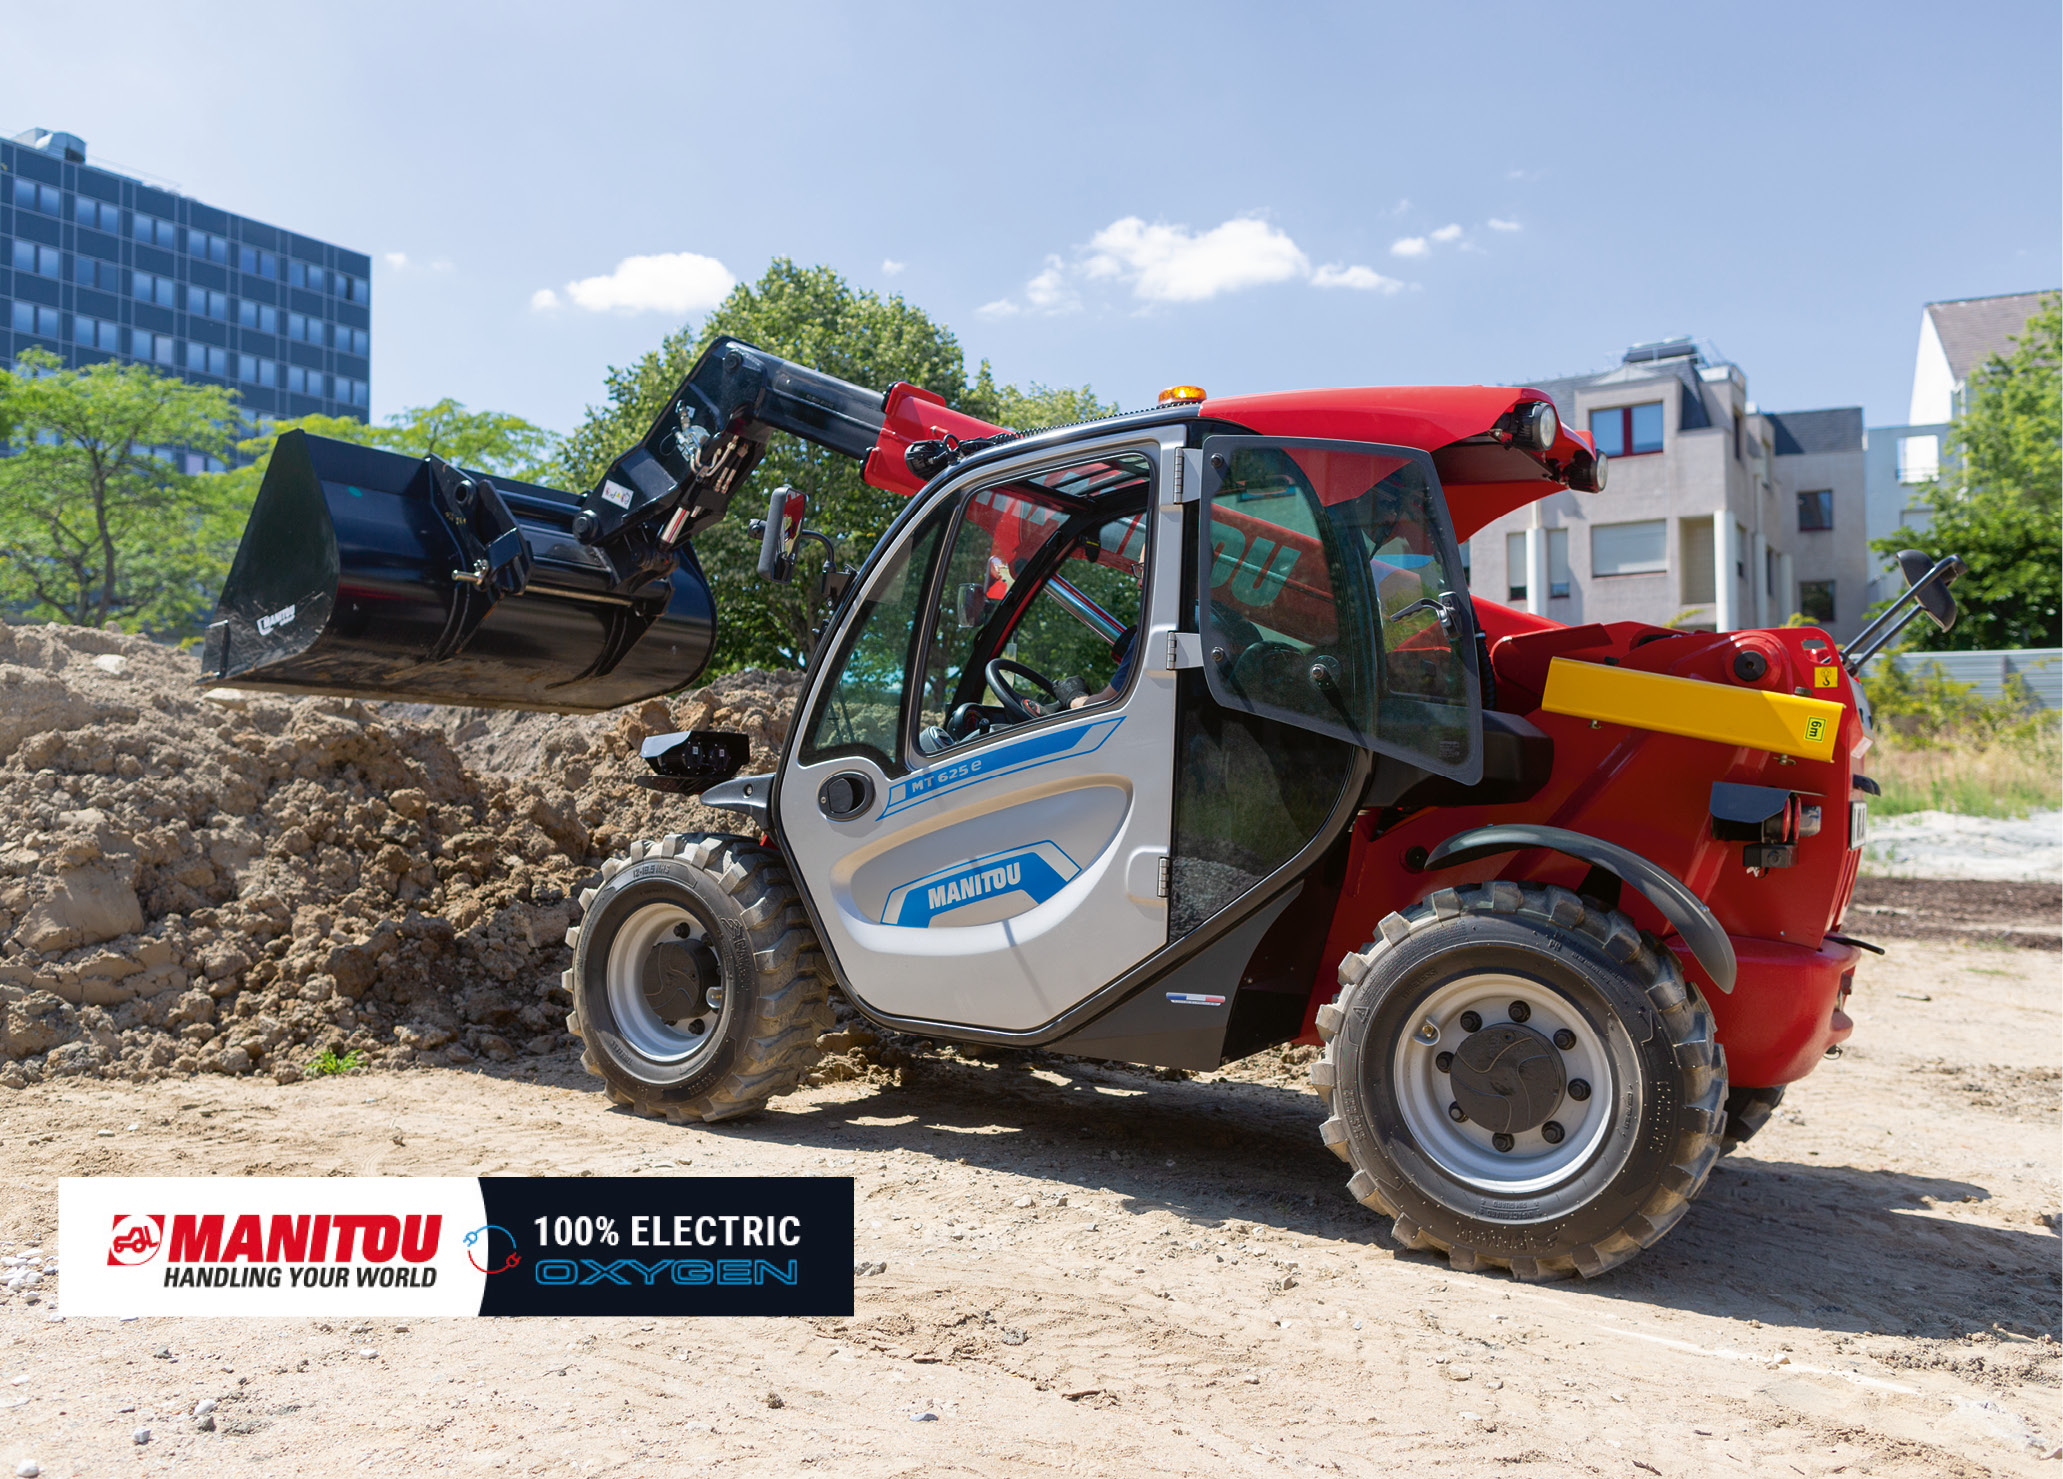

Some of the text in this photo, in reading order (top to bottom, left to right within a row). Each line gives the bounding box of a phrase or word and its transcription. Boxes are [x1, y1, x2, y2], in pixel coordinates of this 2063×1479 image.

[1809, 721, 1822, 737] 6m
[912, 777, 935, 793] MT
[928, 862, 1021, 910] MANITOU
